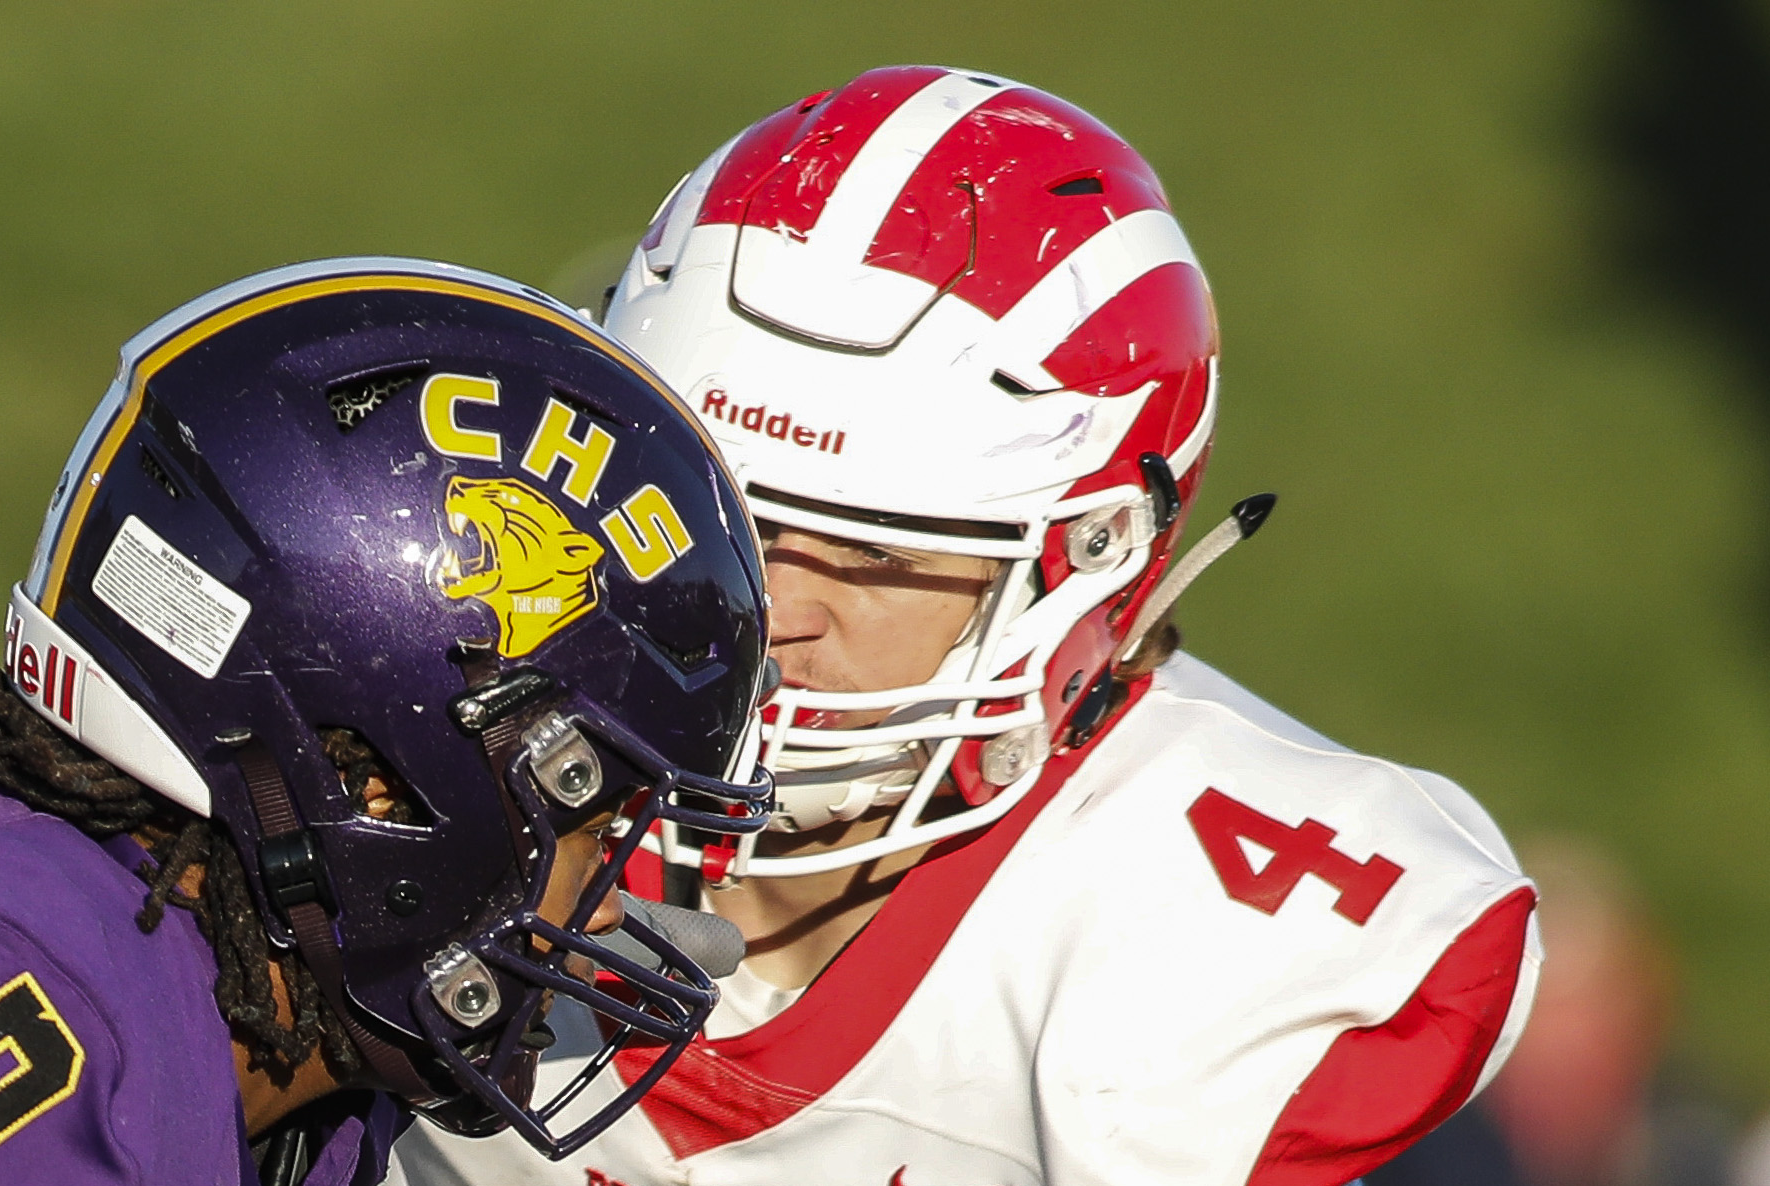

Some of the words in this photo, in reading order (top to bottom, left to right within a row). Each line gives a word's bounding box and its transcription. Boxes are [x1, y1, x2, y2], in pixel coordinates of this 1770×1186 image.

[701, 388, 847, 456] Riddell
[419, 372, 694, 585] CHS
[159, 546, 204, 586] WARNING
[1186, 786, 1406, 927] 4
